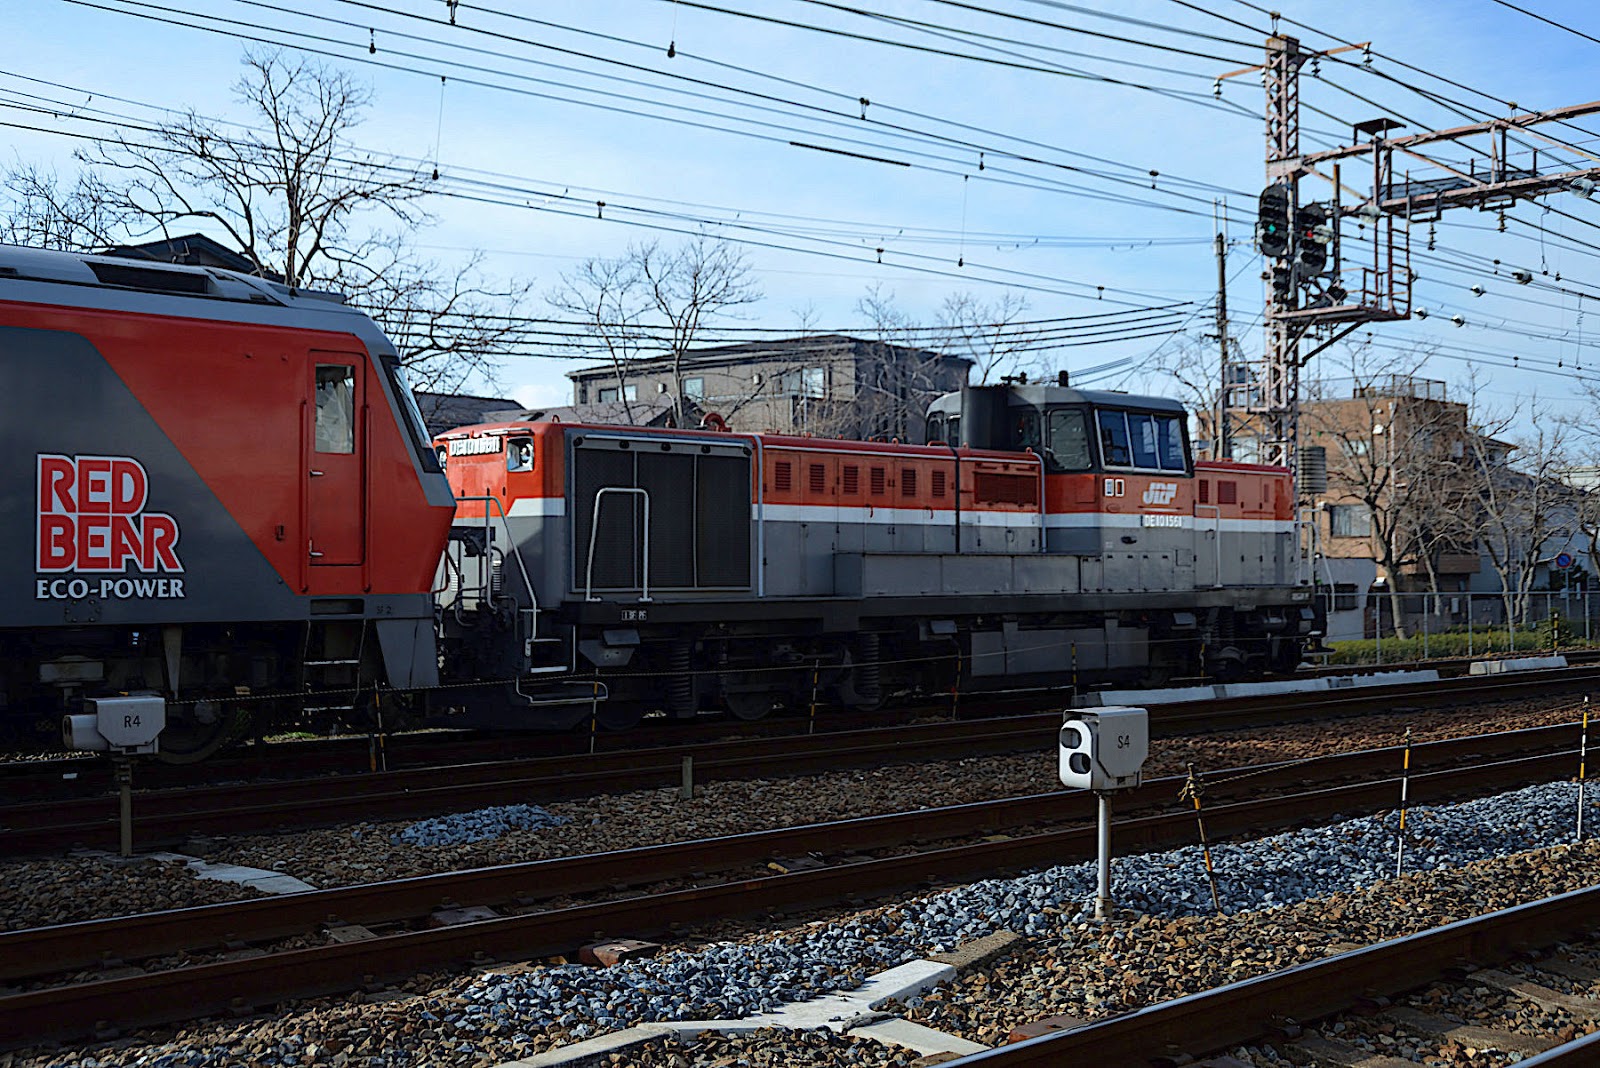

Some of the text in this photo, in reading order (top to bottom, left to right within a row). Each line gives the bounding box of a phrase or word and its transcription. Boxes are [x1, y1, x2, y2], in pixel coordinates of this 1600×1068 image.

[37, 454, 148, 515] RED
[37, 514, 185, 573] BEAR
[36, 579, 186, 599] ECO-POWER
[124, 715, 142, 728] R4
[1117, 734, 1131, 749] S4
